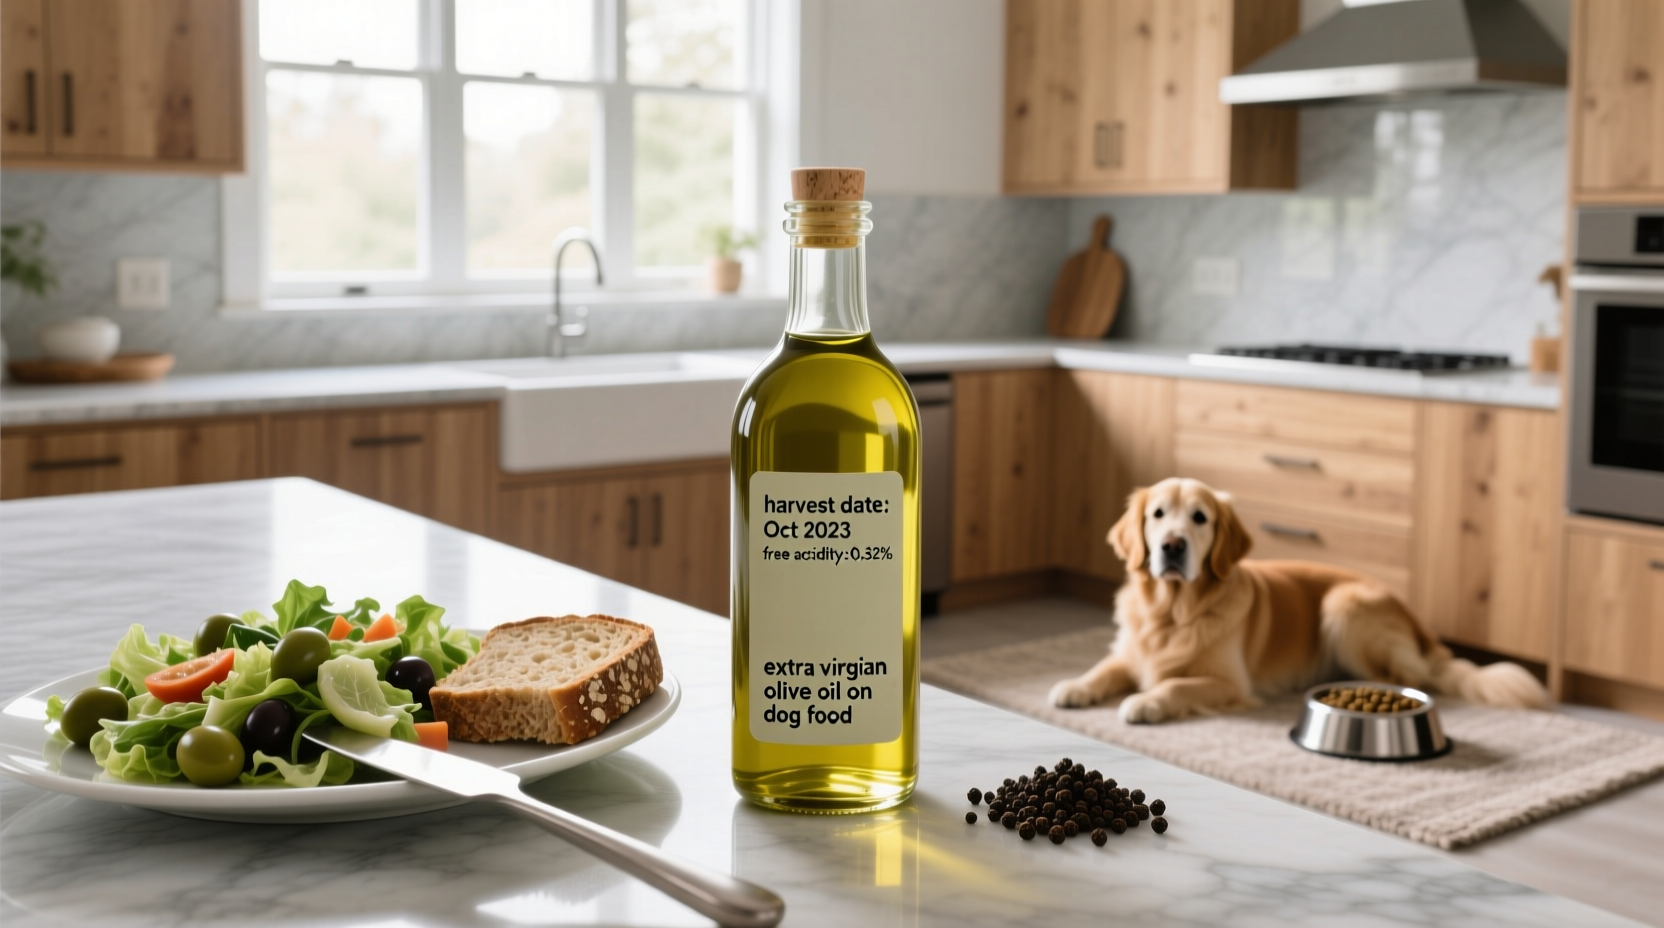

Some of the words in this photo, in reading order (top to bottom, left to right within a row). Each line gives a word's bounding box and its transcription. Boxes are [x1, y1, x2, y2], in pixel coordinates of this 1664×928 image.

[764, 494, 836, 514] harvest
[840, 495, 889, 514] date:
[763, 520, 799, 538] Oct
[803, 521, 851, 539] 2023
[763, 546, 790, 560] free
[763, 659, 815, 676] extra
[819, 656, 888, 681] virgian
[763, 680, 812, 700] olive
[817, 680, 841, 700] oil
[846, 685, 872, 700] on
[763, 703, 801, 729] dog
[807, 704, 852, 724] food
